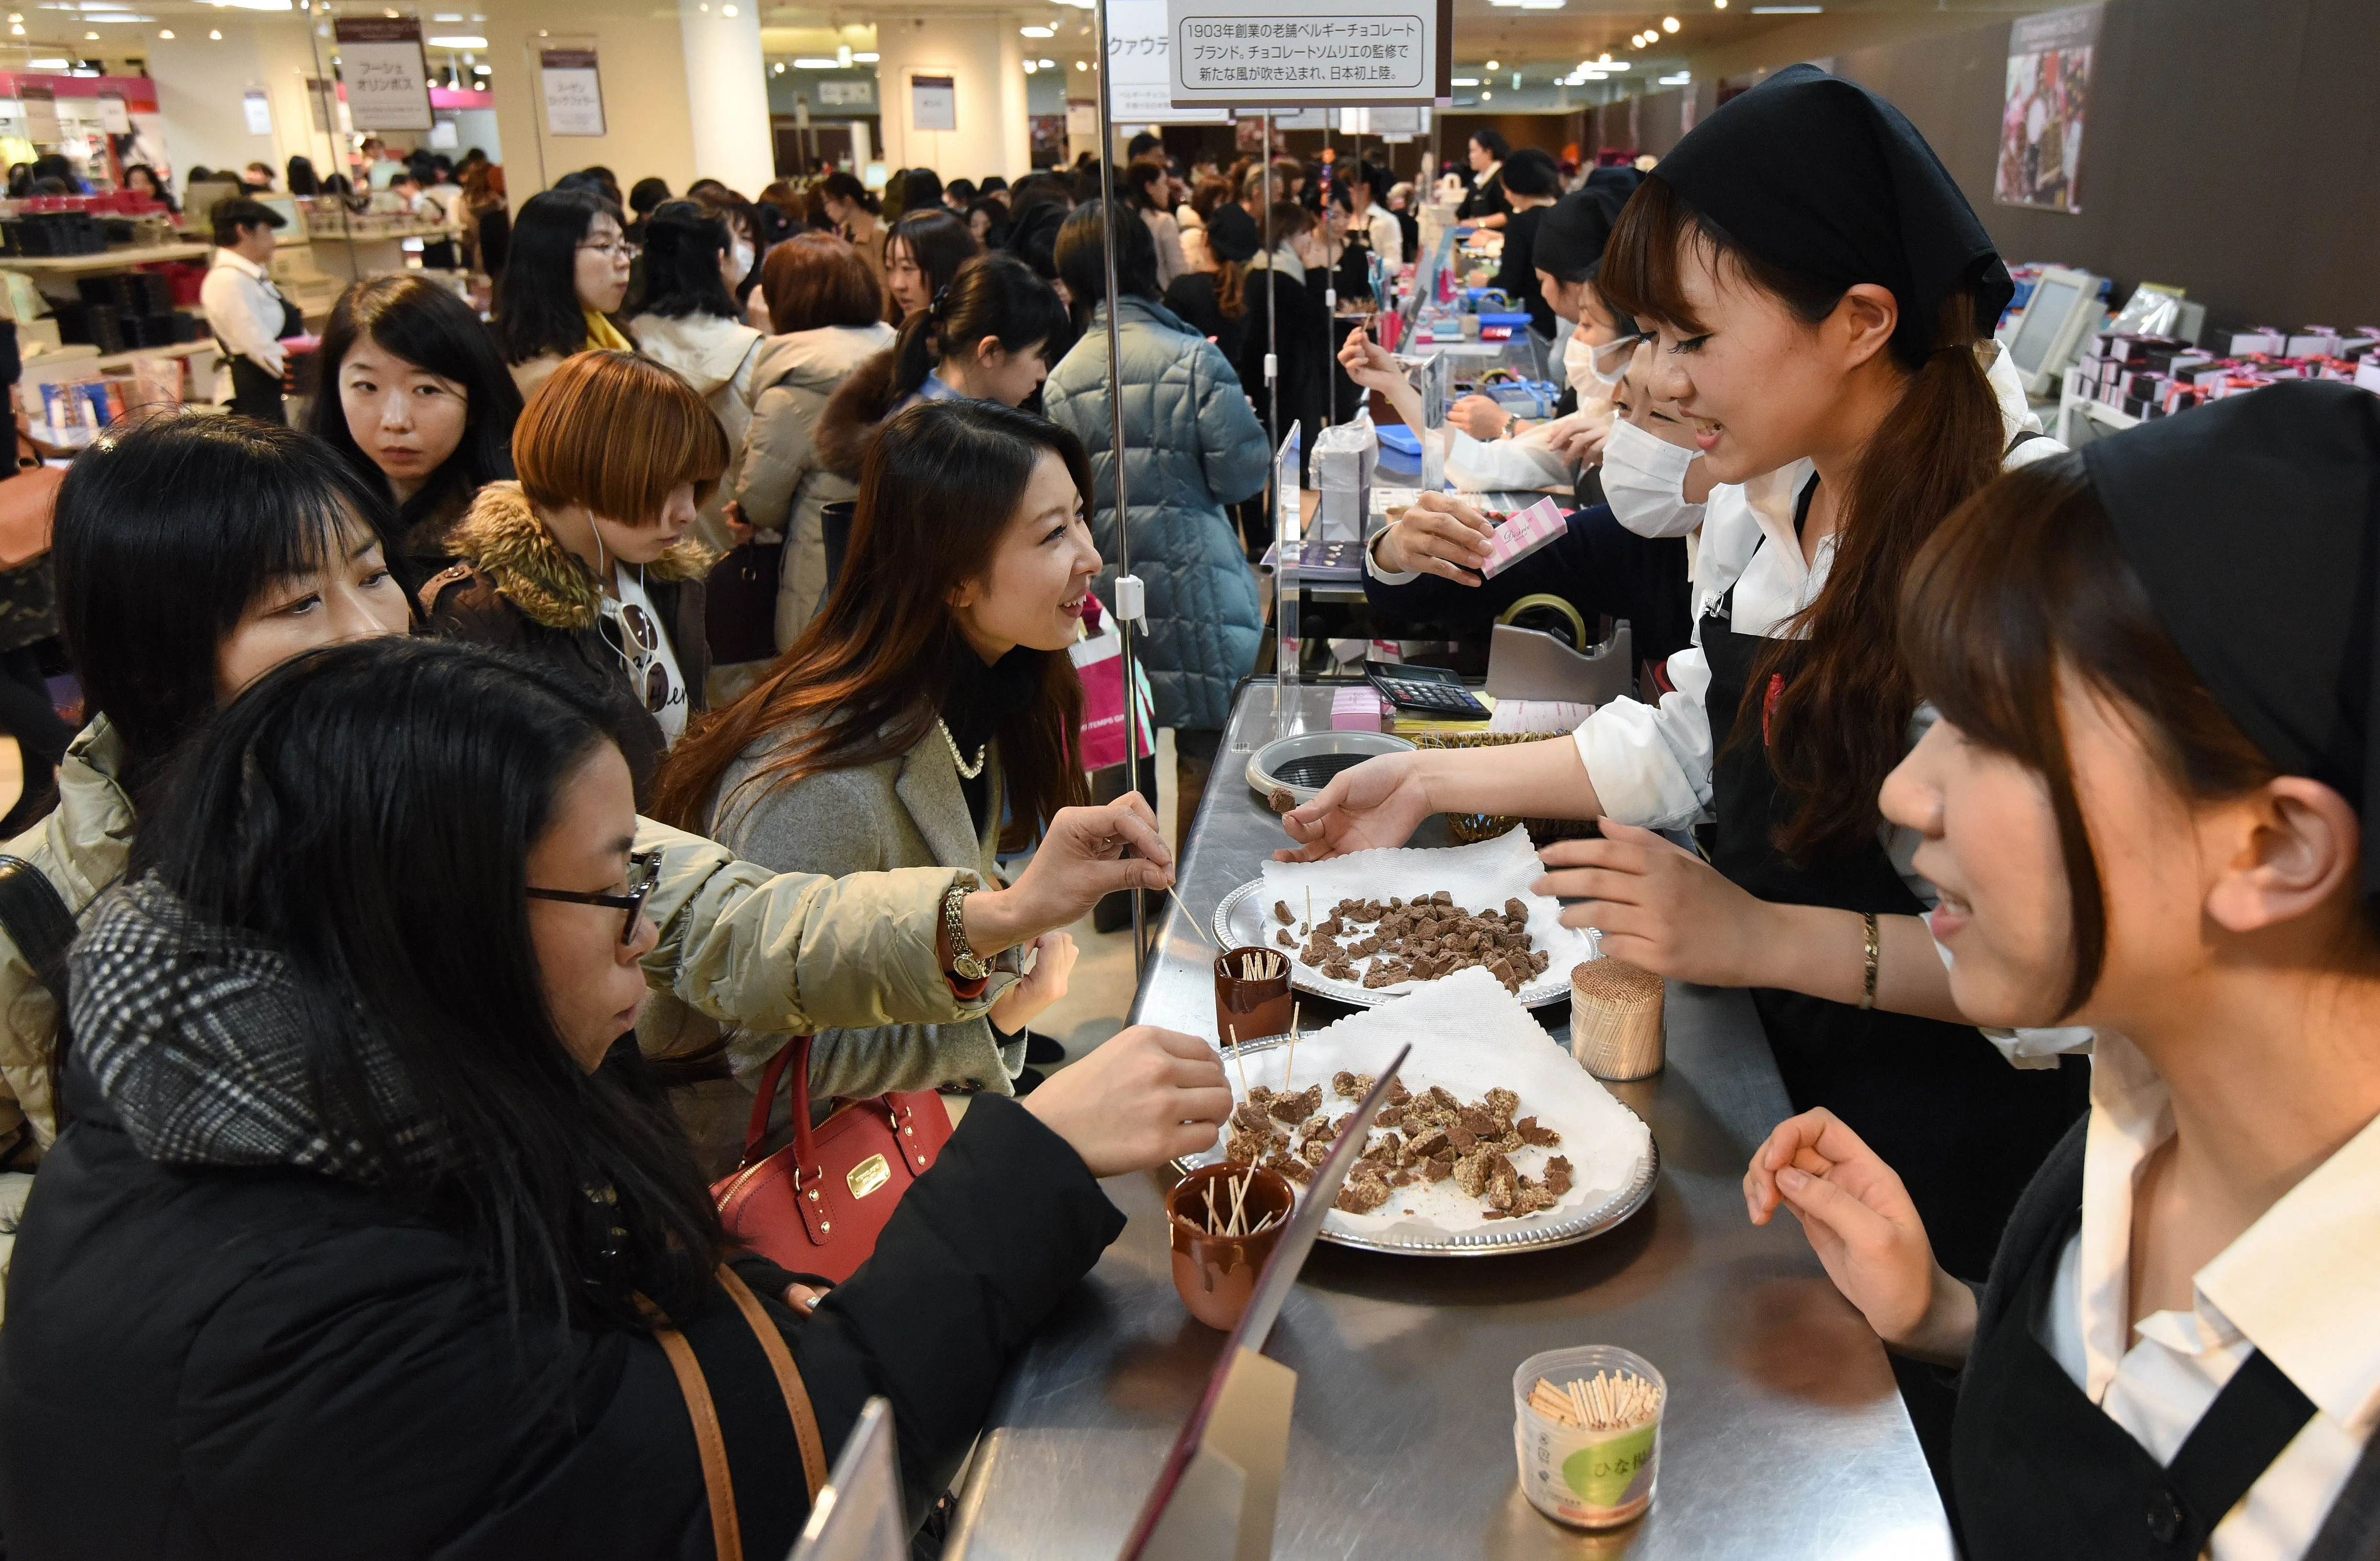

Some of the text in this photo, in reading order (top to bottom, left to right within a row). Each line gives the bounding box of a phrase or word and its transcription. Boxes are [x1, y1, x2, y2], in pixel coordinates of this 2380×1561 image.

[1188, 23, 1415, 38] 1903年創業の老舗ベルギーチョコレート
[1193, 44, 1408, 60] ブランド。チョコレートソムリエの監修で
[1199, 66, 1396, 82] 新たな風が吹き込まれ、日本初上陸。
